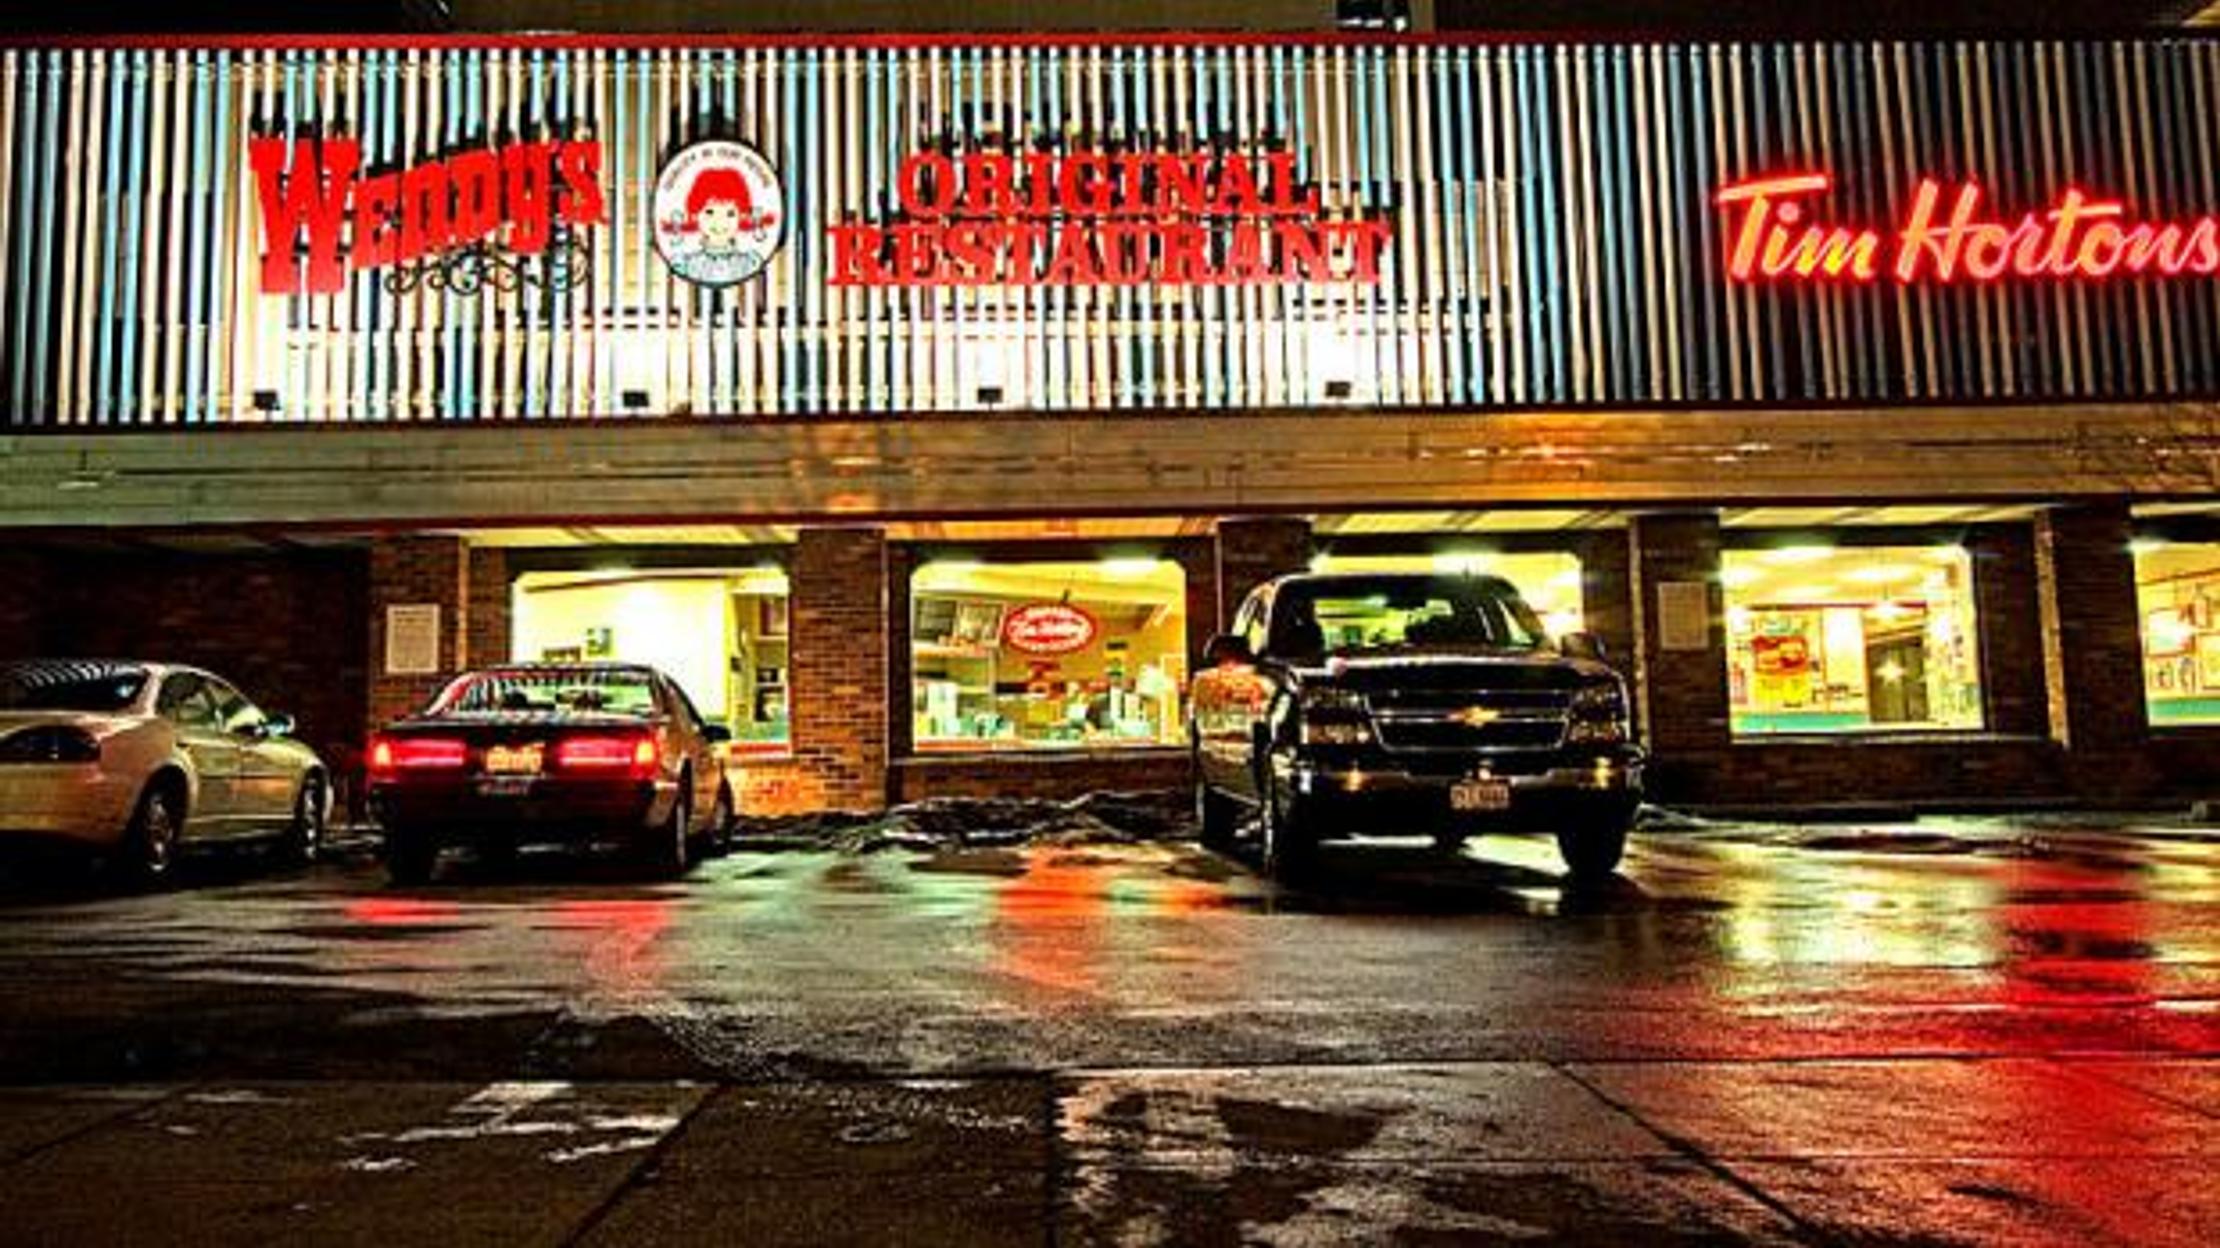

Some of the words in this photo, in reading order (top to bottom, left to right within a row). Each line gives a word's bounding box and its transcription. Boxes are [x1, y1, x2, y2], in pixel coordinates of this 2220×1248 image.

[897, 149, 1318, 216] ORIGINAL
[827, 215, 1393, 286] RESTAURANT
[1717, 173, 1880, 282] Tim
[1892, 176, 2220, 284] Hortons
